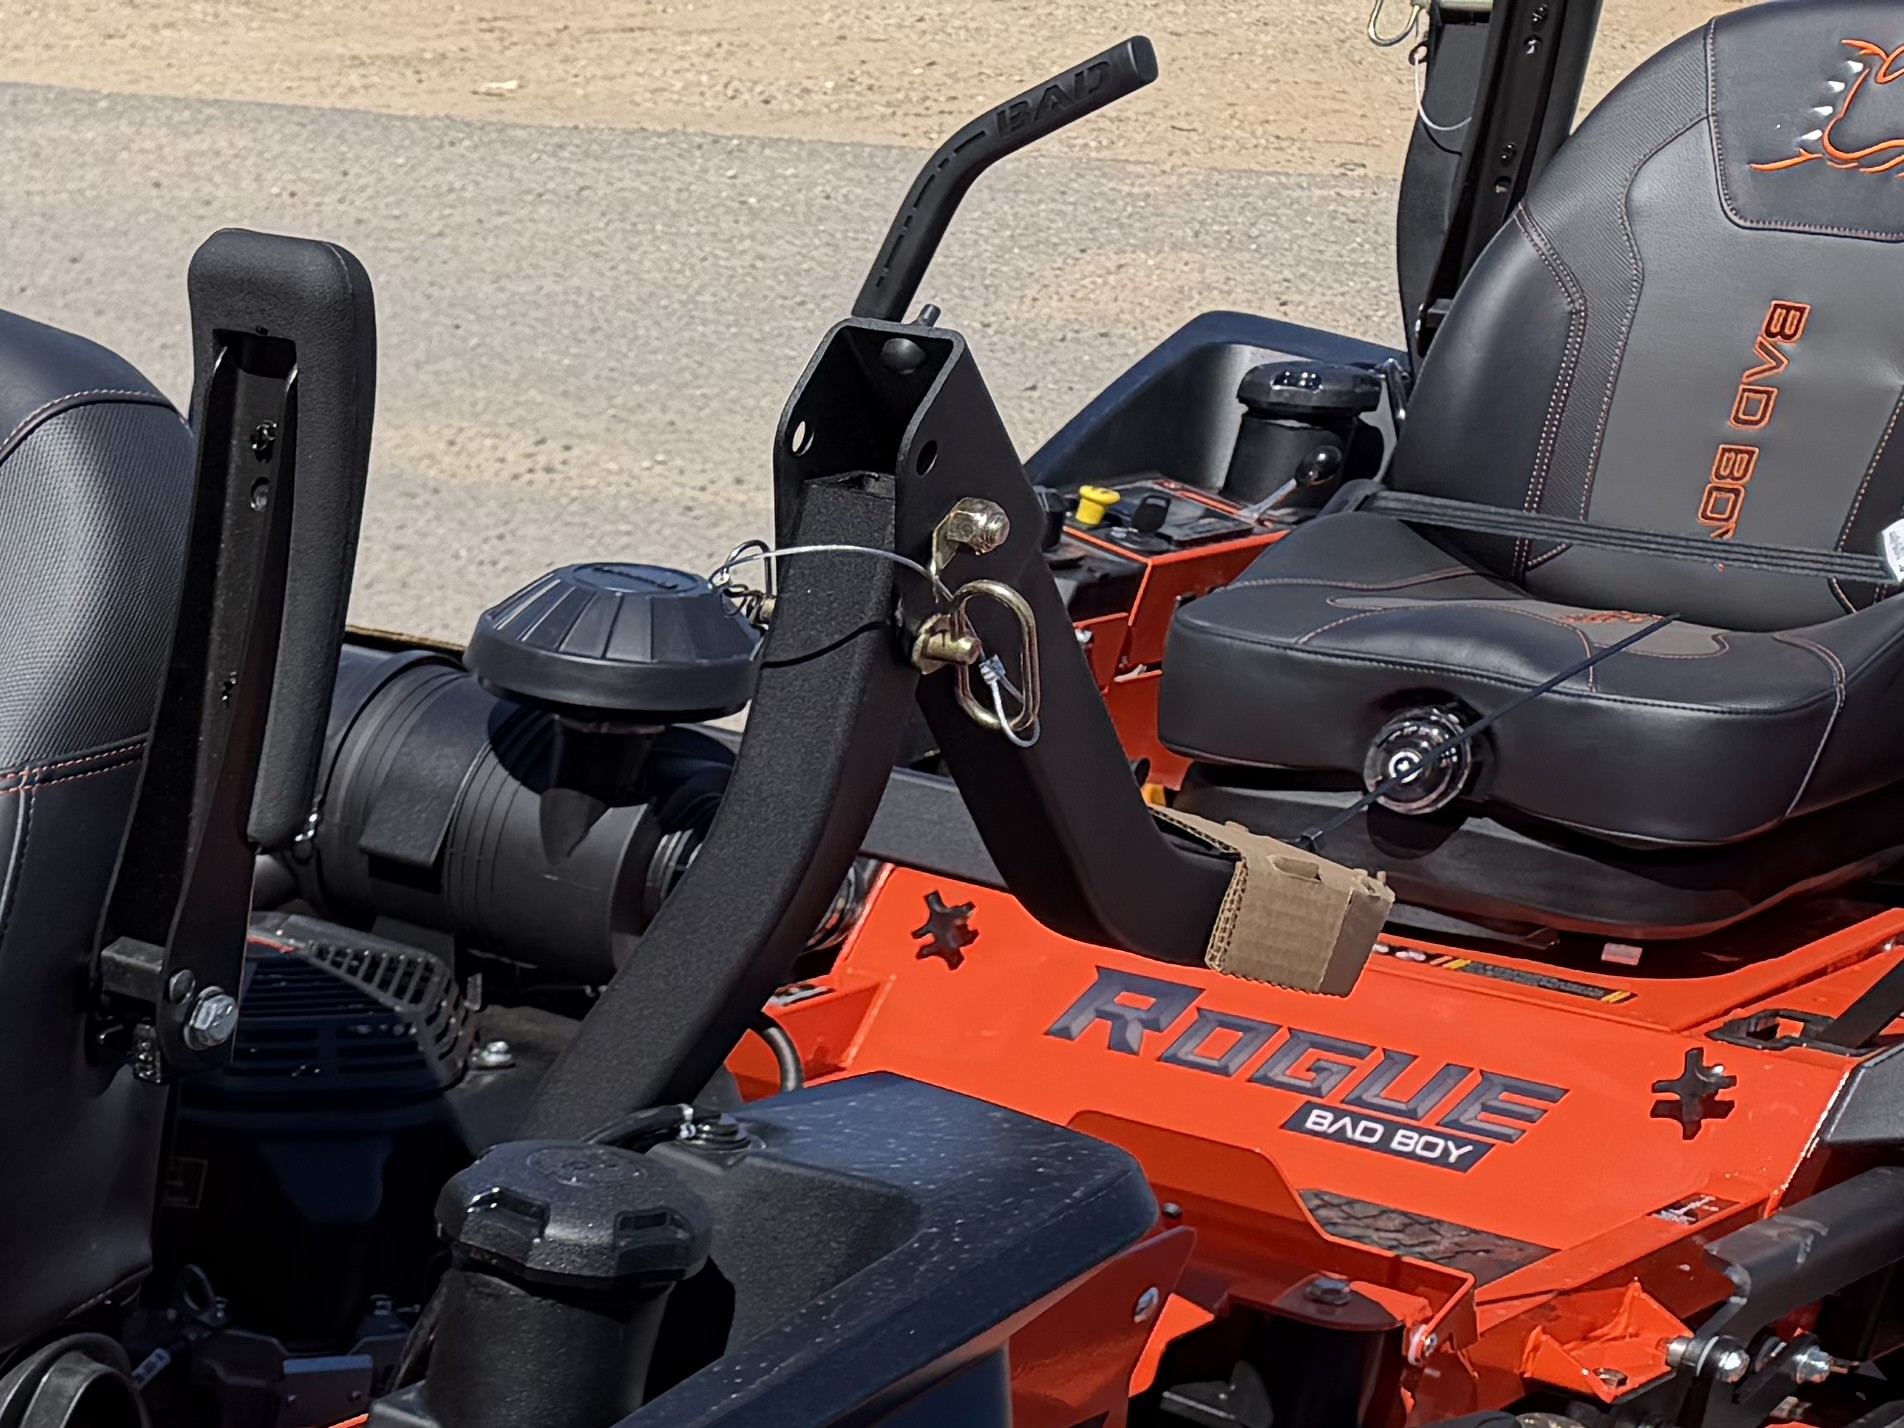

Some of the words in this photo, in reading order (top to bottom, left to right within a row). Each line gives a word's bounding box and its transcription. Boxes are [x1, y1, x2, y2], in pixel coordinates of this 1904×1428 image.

[1728, 298, 1811, 430] BAD
[1044, 965, 1569, 1144] ROGUE
[1305, 1108, 1382, 1147] BAD
[1390, 1127, 1474, 1167] BOY
